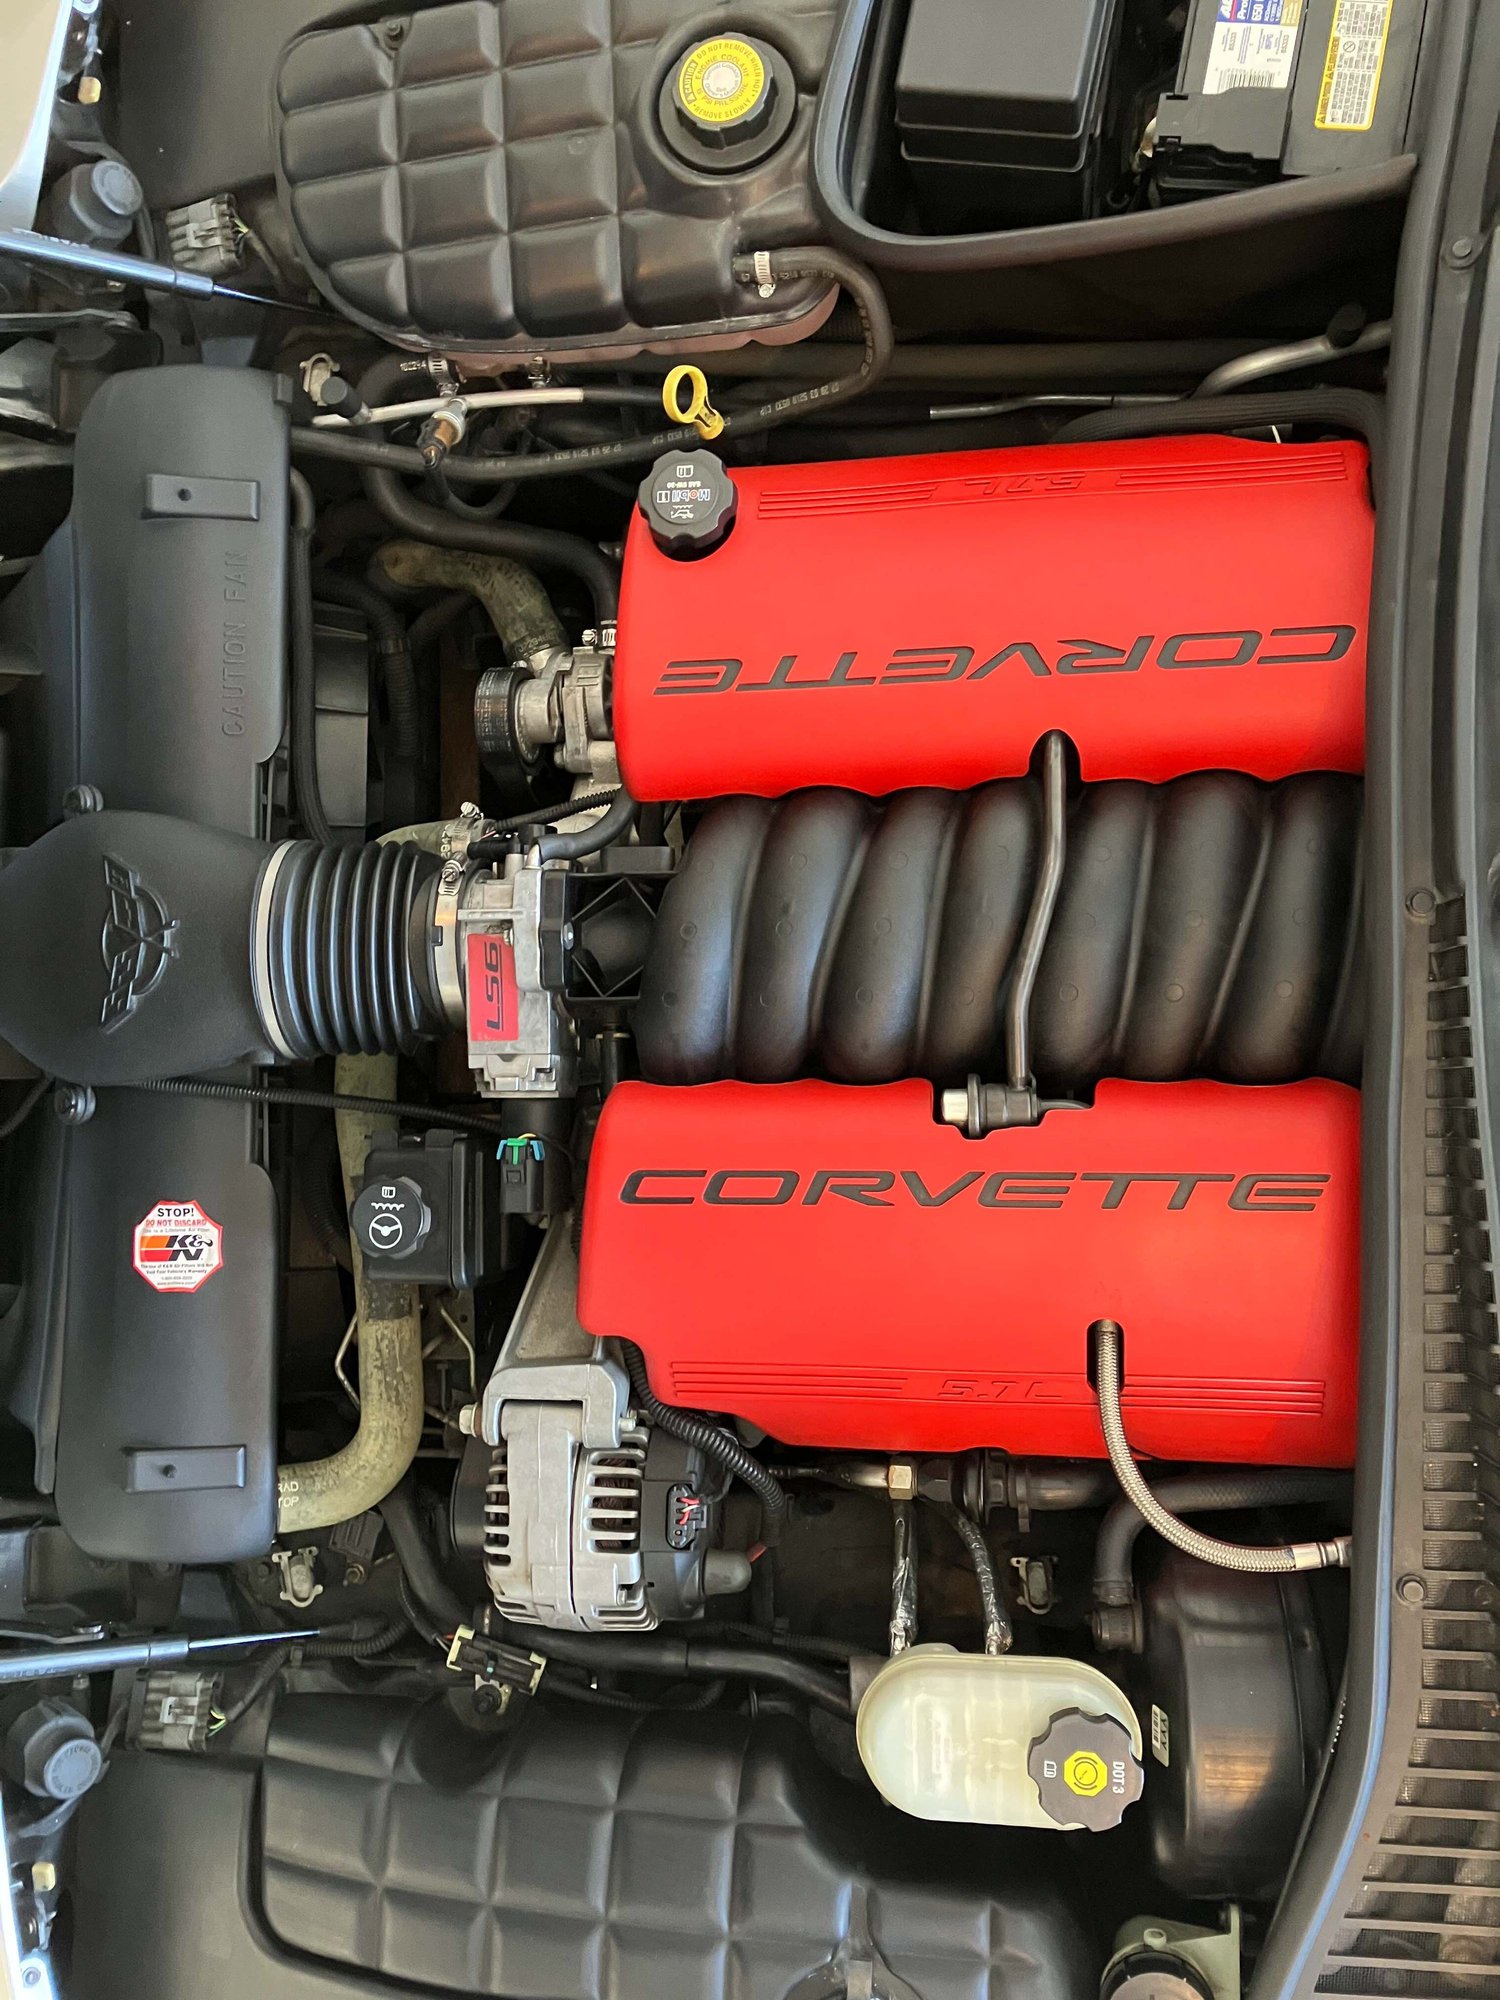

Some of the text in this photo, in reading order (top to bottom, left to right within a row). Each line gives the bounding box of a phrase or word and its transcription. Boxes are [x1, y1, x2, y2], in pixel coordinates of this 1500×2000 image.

[1251, 3, 1264, 21] 650
[697, 50, 707, 59] DO
[708, 43, 722, 53] NOT
[724, 43, 752, 58] REMOVE
[683, 60, 698, 93] CAUTION
[721, 54, 750, 77] COOLANT
[694, 98, 751, 119] REMOVE SLOWLY
[965, 472, 1086, 495] 5.7L
[672, 489, 710, 502] Mobil
[222, 552, 248, 737] CAUTION FAN
[652, 624, 1357, 696] CORVETTE
[484, 942, 501, 1030] LS6
[619, 1169, 1331, 1211] CORVETTE
[158, 1208, 194, 1217] STOP!
[937, 1380, 1062, 1398] 5.7L
[277, 1481, 299, 1493] RAD
[1112, 1761, 1125, 1787] DOT
